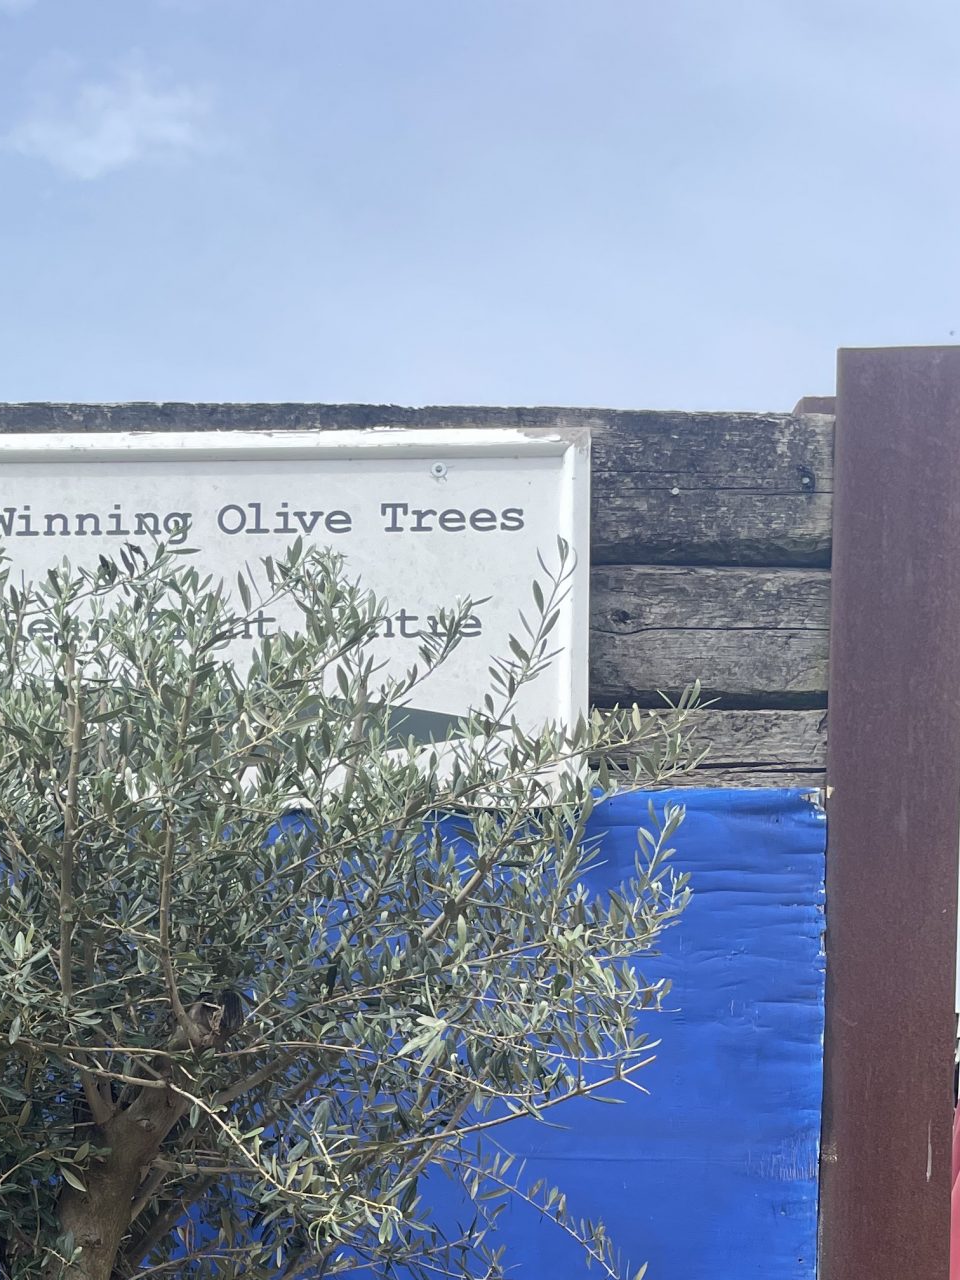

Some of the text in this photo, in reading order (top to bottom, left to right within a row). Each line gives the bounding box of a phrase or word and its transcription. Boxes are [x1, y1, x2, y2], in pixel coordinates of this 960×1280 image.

[216, 501, 353, 536] Olive
[380, 502, 526, 533] Trees
[304, 607, 483, 639] ntre
